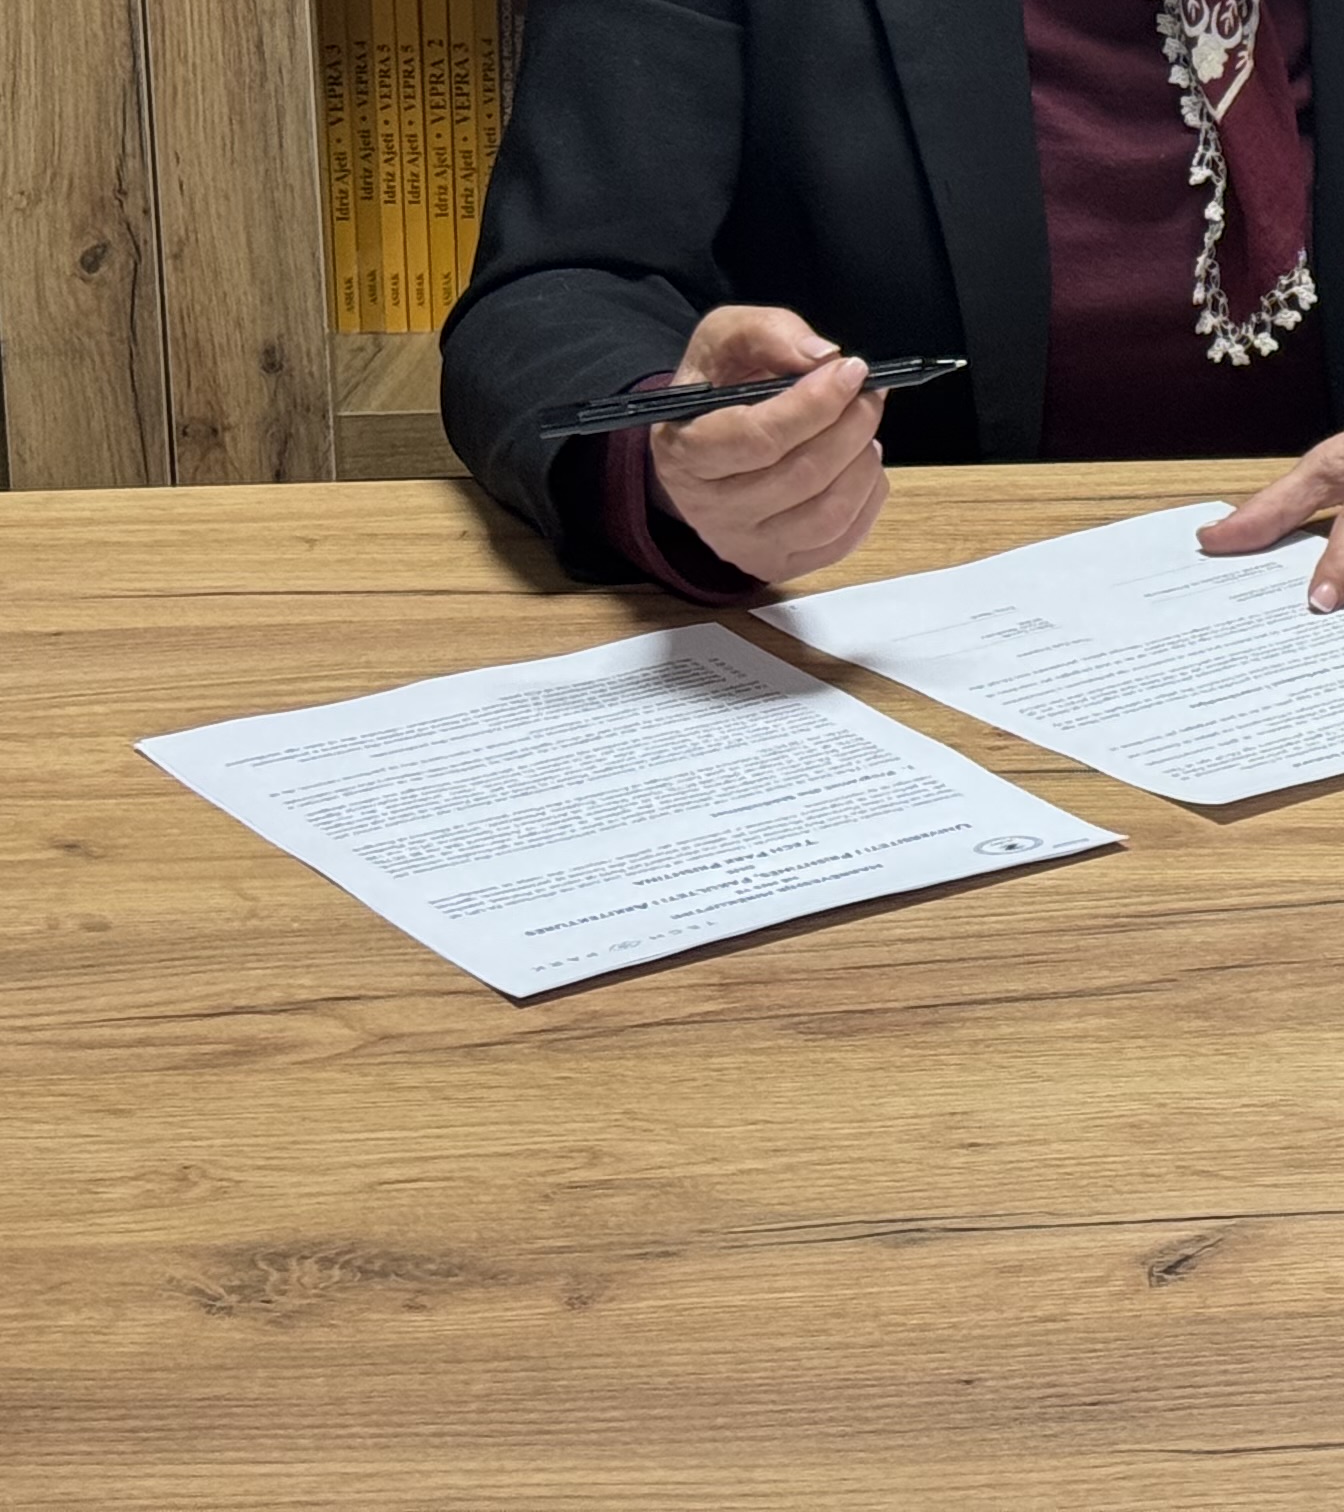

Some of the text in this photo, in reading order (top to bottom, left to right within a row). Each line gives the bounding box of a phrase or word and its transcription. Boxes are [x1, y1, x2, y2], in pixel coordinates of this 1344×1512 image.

[328, 60, 345, 128] VEPRA
[355, 52, 371, 109] VEPRA
[379, 56, 393, 113] VEPRA
[402, 56, 417, 113] VEPRA
[482, 51, 497, 106] VEPRA
[358, 129, 375, 164] Ajeti
[428, 39, 451, 219] Idriz Ajeti VEPRA 2
[454, 41, 477, 220] Idriz Ajeti VEPRA 3
[333, 151, 352, 185] Ajeti
[381, 132, 399, 168] Ajeti
[406, 132, 423, 169] Ajeti
[359, 167, 374, 201] Idriz
[382, 170, 397, 205] Idriz
[406, 170, 421, 205] Idriz
[334, 187, 350, 223] Idriz
